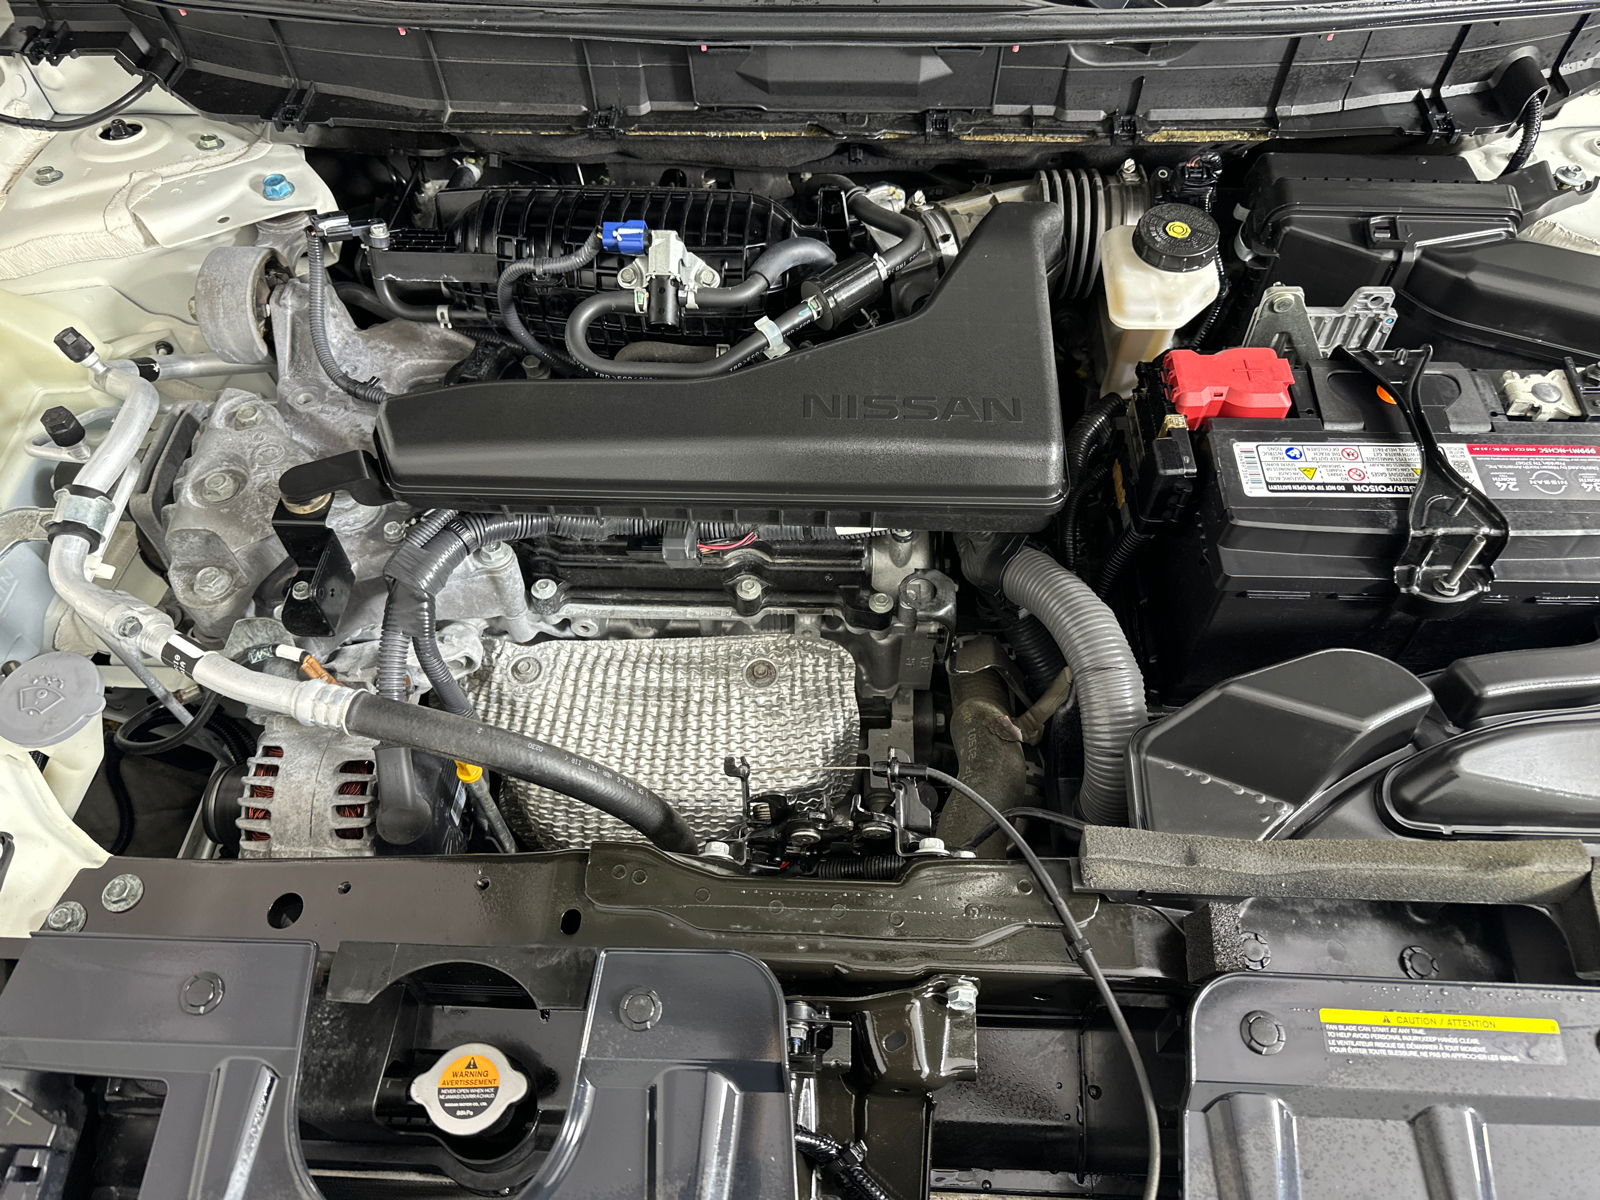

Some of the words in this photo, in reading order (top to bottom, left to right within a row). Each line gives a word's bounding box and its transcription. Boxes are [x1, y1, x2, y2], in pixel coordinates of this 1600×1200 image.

[802, 394, 1023, 423] NISSAN
[1495, 482, 1519, 491] 24
[1396, 1017, 1436, 1025] CAUTION
[1447, 1019, 1496, 1028] ATTENTION
[1406, 1042, 1438, 1050] DÉMARRER
